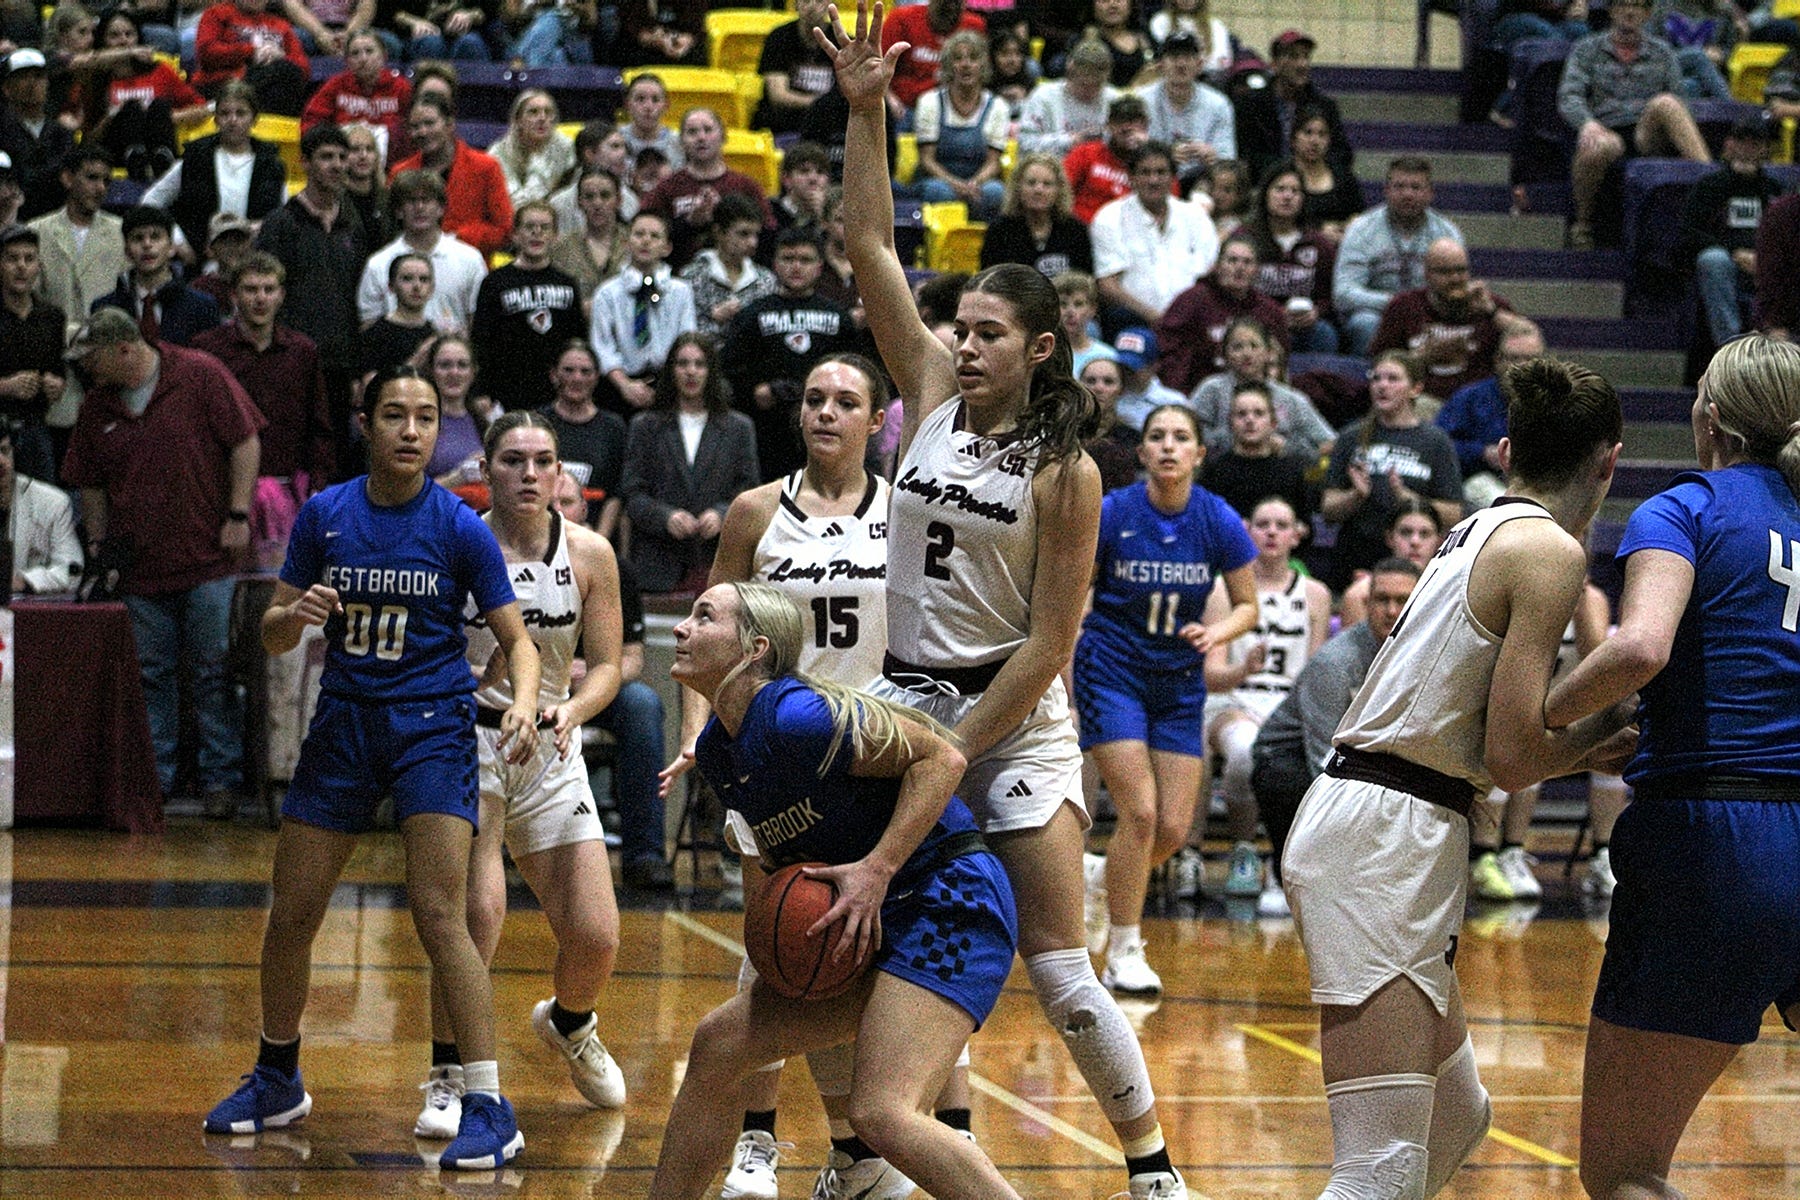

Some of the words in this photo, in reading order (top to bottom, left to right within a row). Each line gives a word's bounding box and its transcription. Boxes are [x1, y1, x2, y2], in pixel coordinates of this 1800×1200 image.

[767, 557, 826, 584] Lady
[924, 520, 955, 581] 2
[1767, 528, 1800, 633] 4
[344, 603, 409, 661] 00
[811, 596, 859, 649] 15
[1147, 591, 1180, 636] 11
